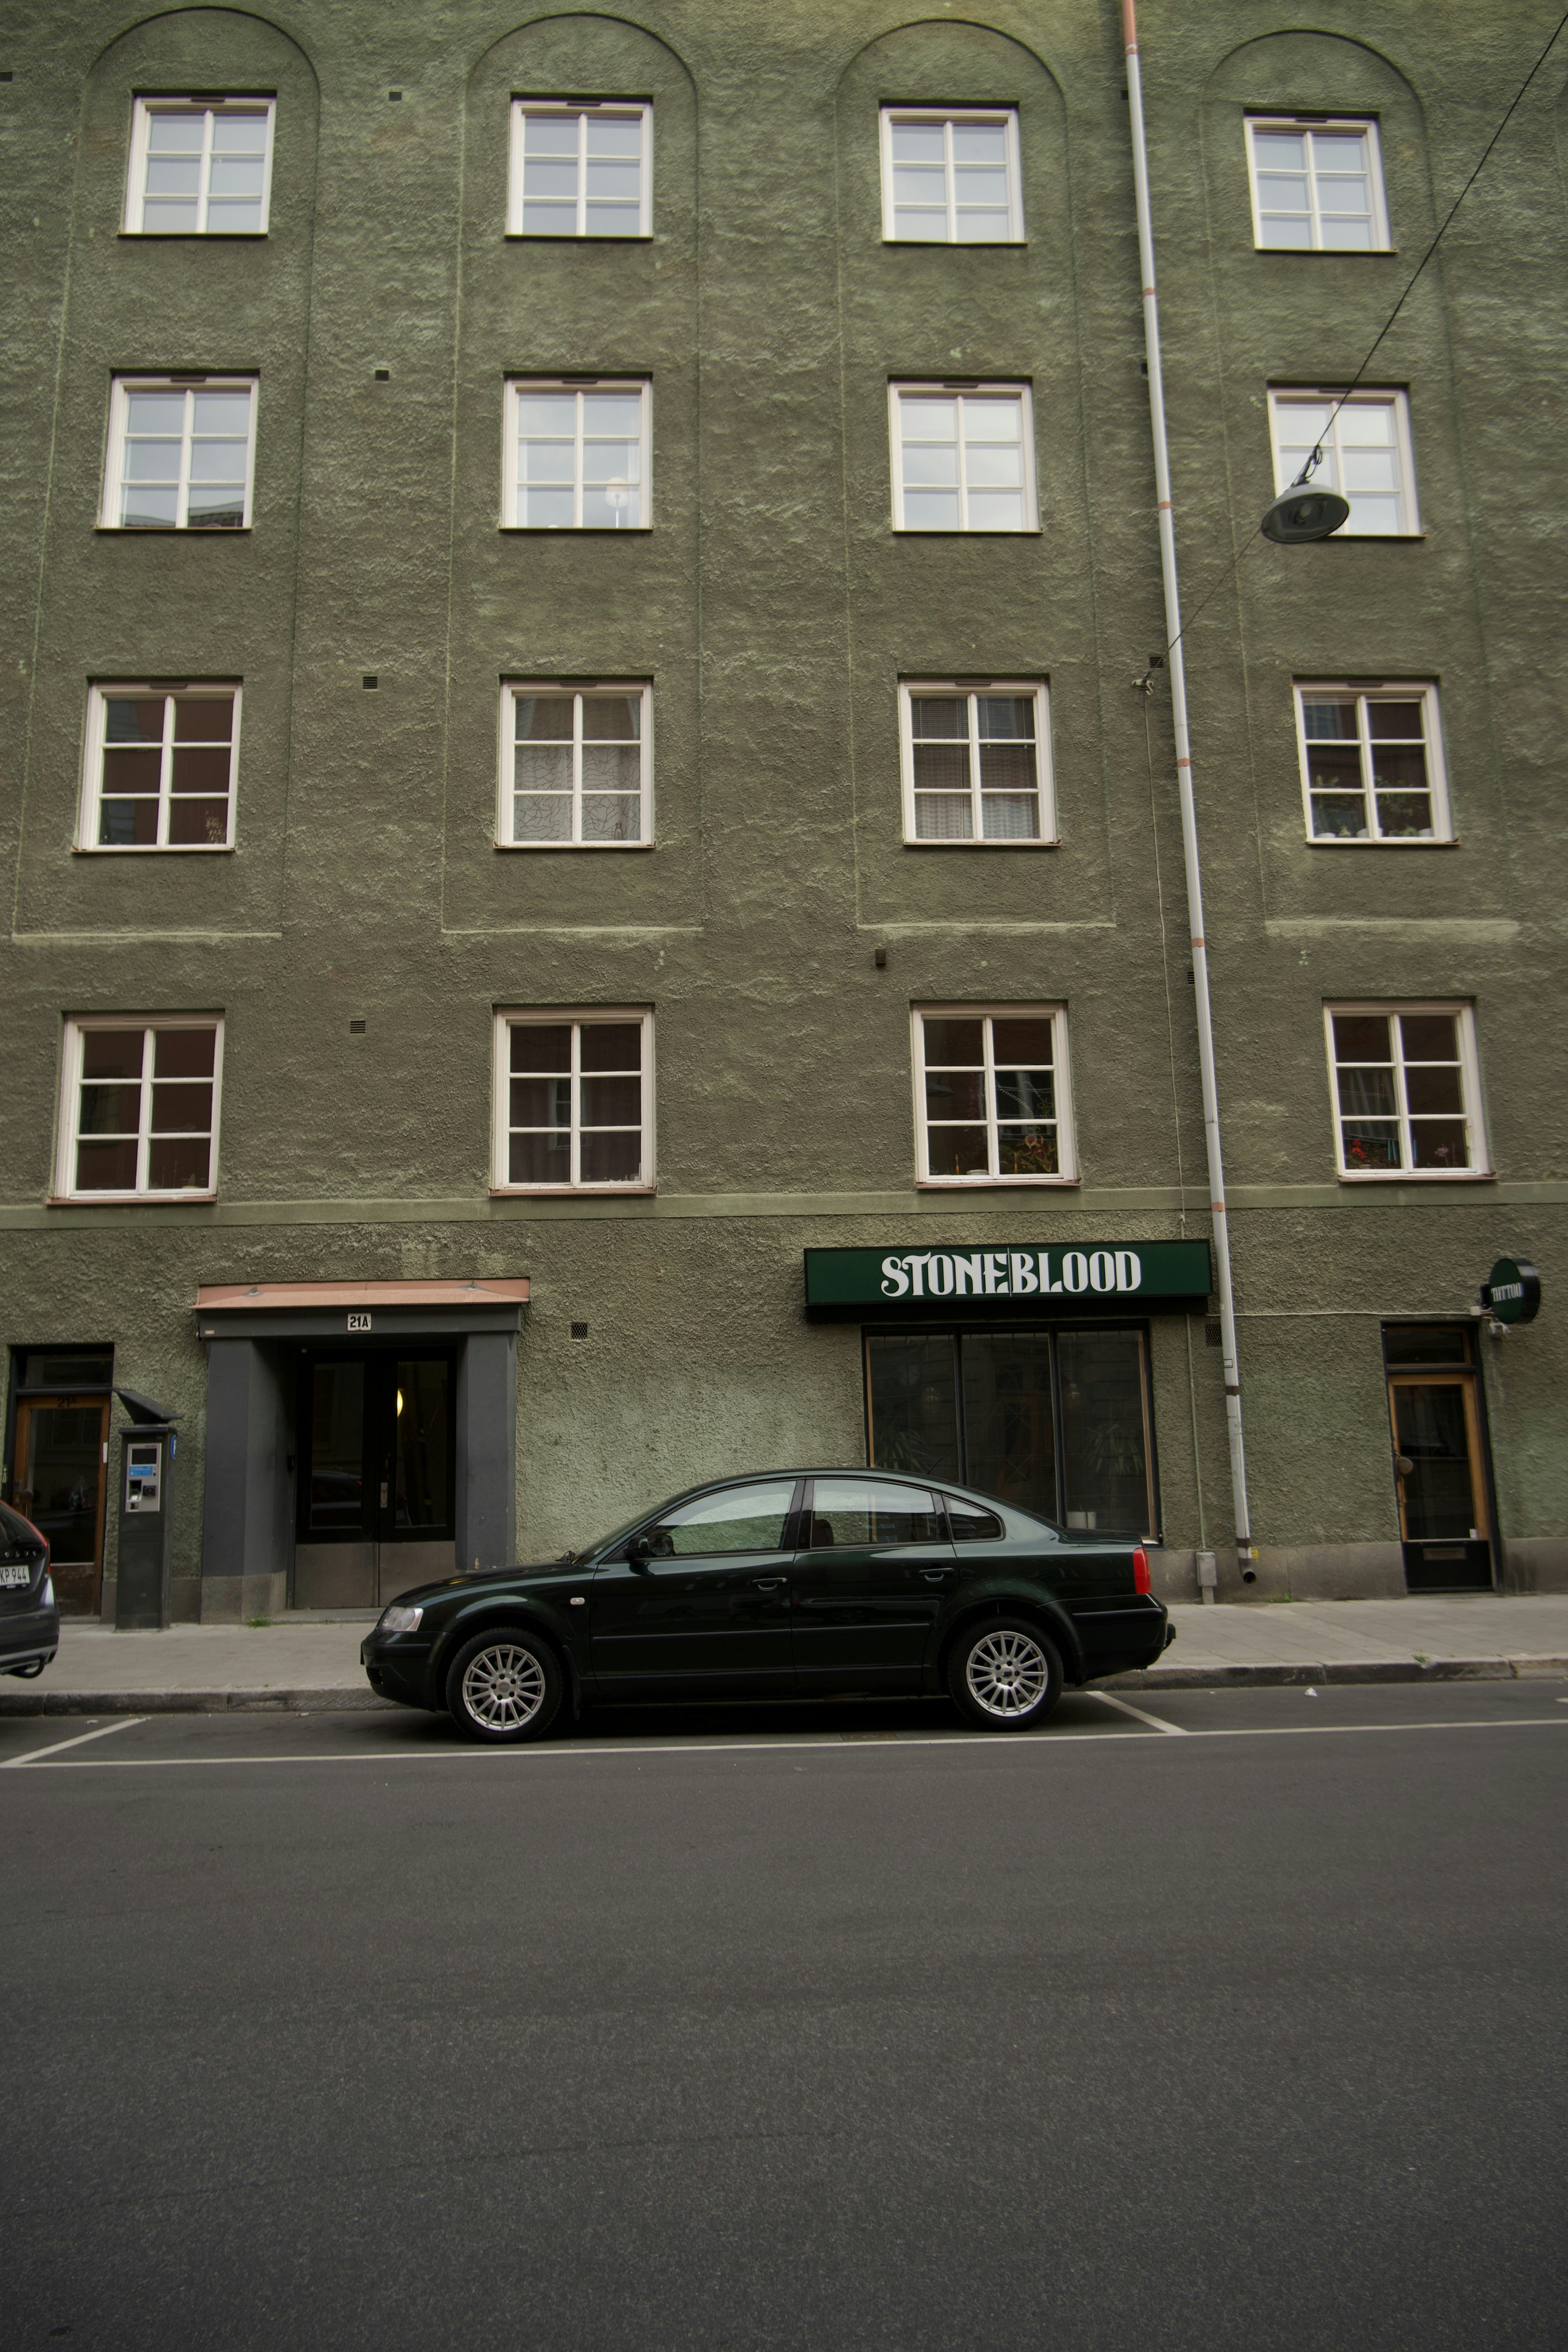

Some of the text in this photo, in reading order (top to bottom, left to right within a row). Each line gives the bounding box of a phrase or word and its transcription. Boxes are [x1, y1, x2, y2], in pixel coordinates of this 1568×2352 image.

[881, 1251, 1142, 1297] STONEBLOOD
[1491, 1282, 1521, 1302] TATTOO
[350, 1316, 368, 1328] 21A
[12, 1567, 26, 1583] 944
